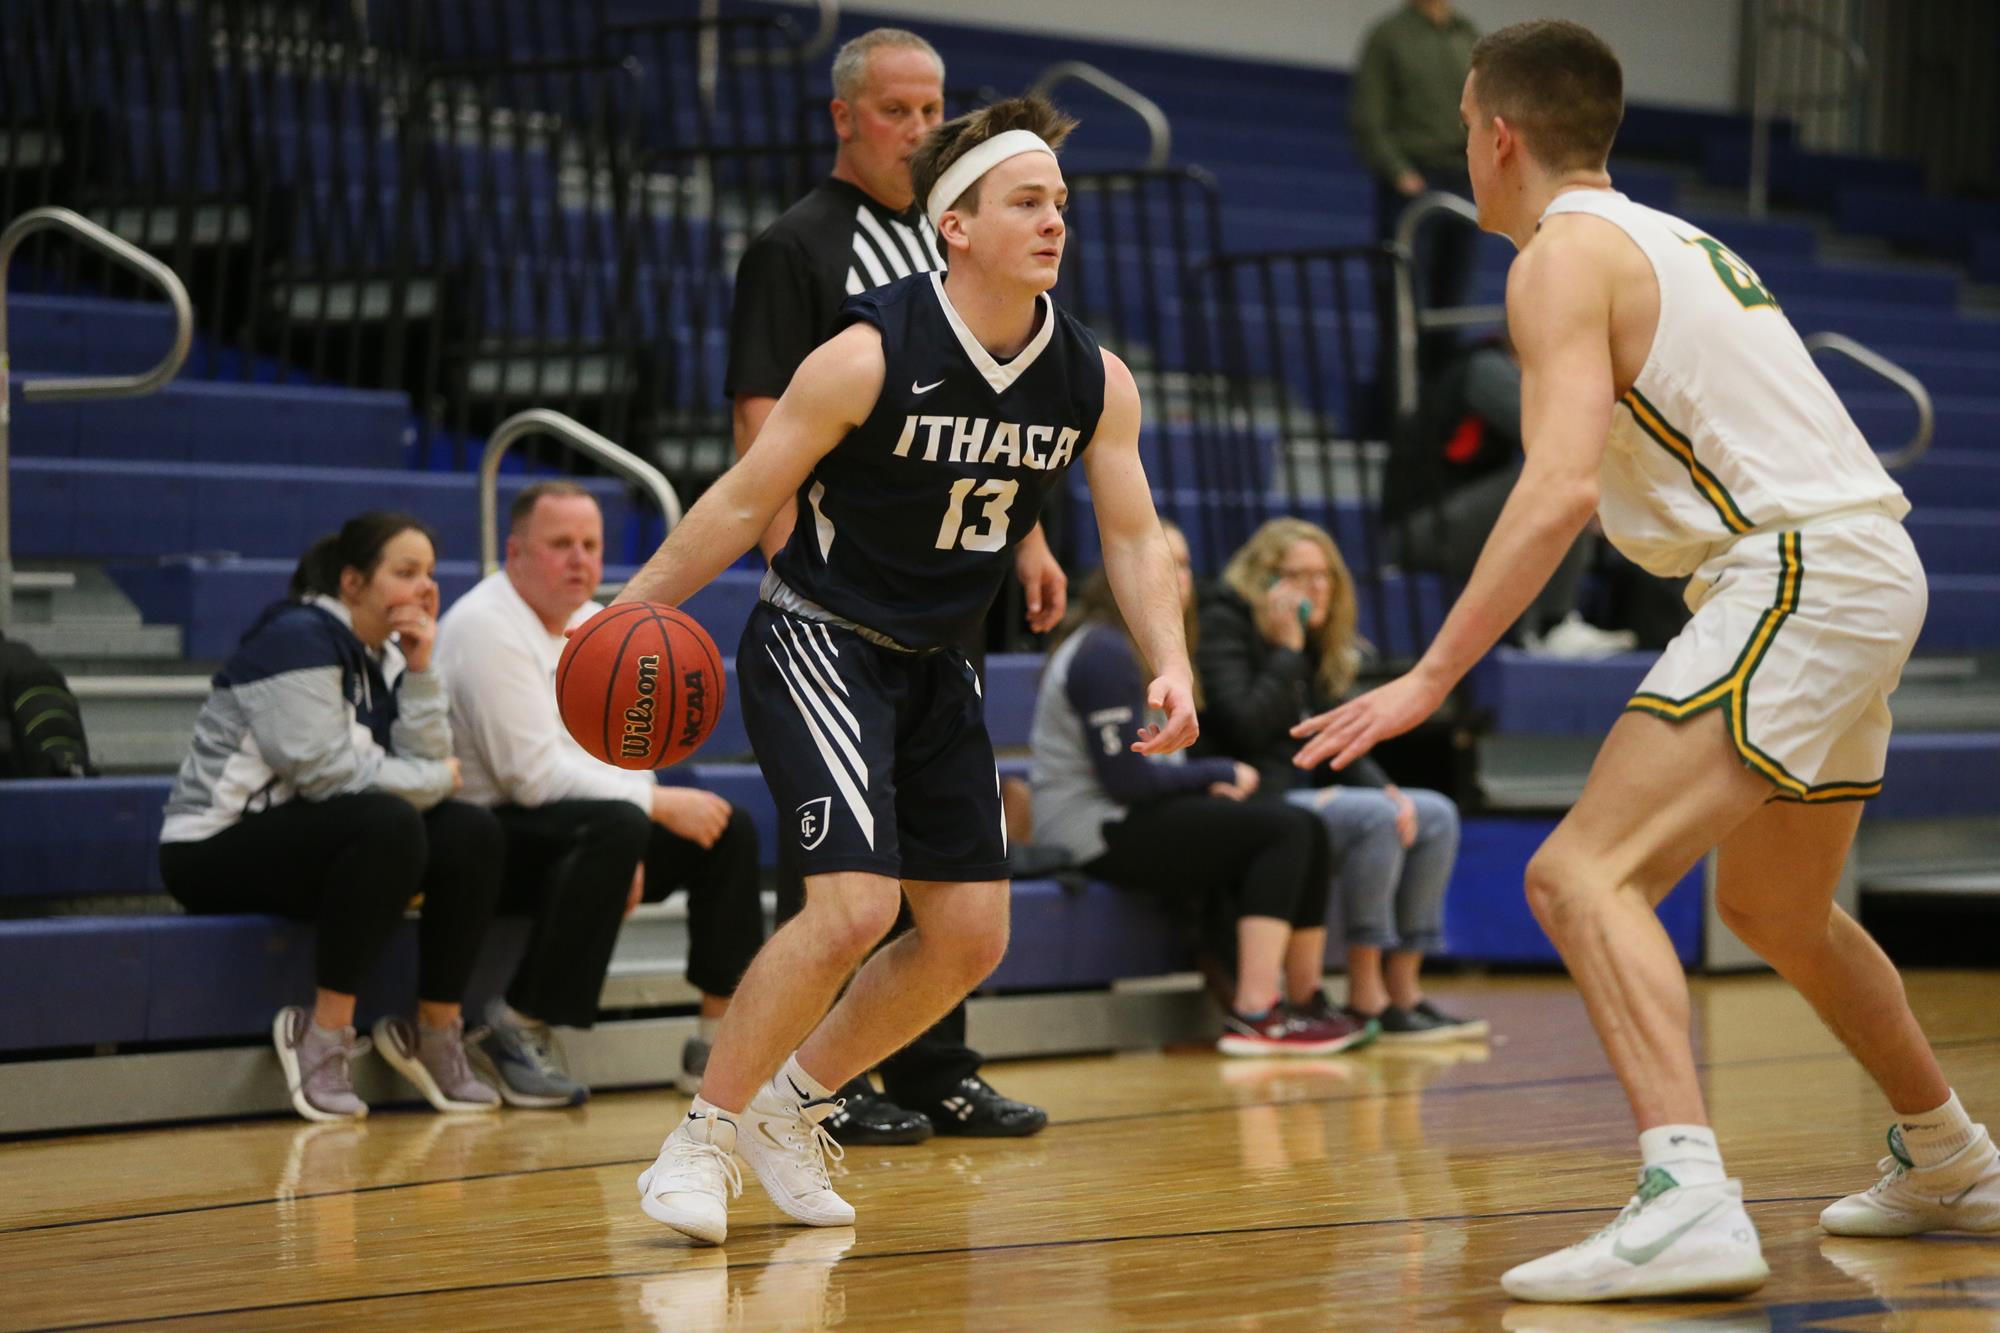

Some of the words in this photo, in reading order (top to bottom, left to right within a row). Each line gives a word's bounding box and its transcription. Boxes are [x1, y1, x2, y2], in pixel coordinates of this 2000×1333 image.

[892, 415, 1081, 470] ITHACA
[934, 478, 1020, 553] 13
[620, 654, 660, 759] Wilson
[679, 669, 705, 747] NCAA
